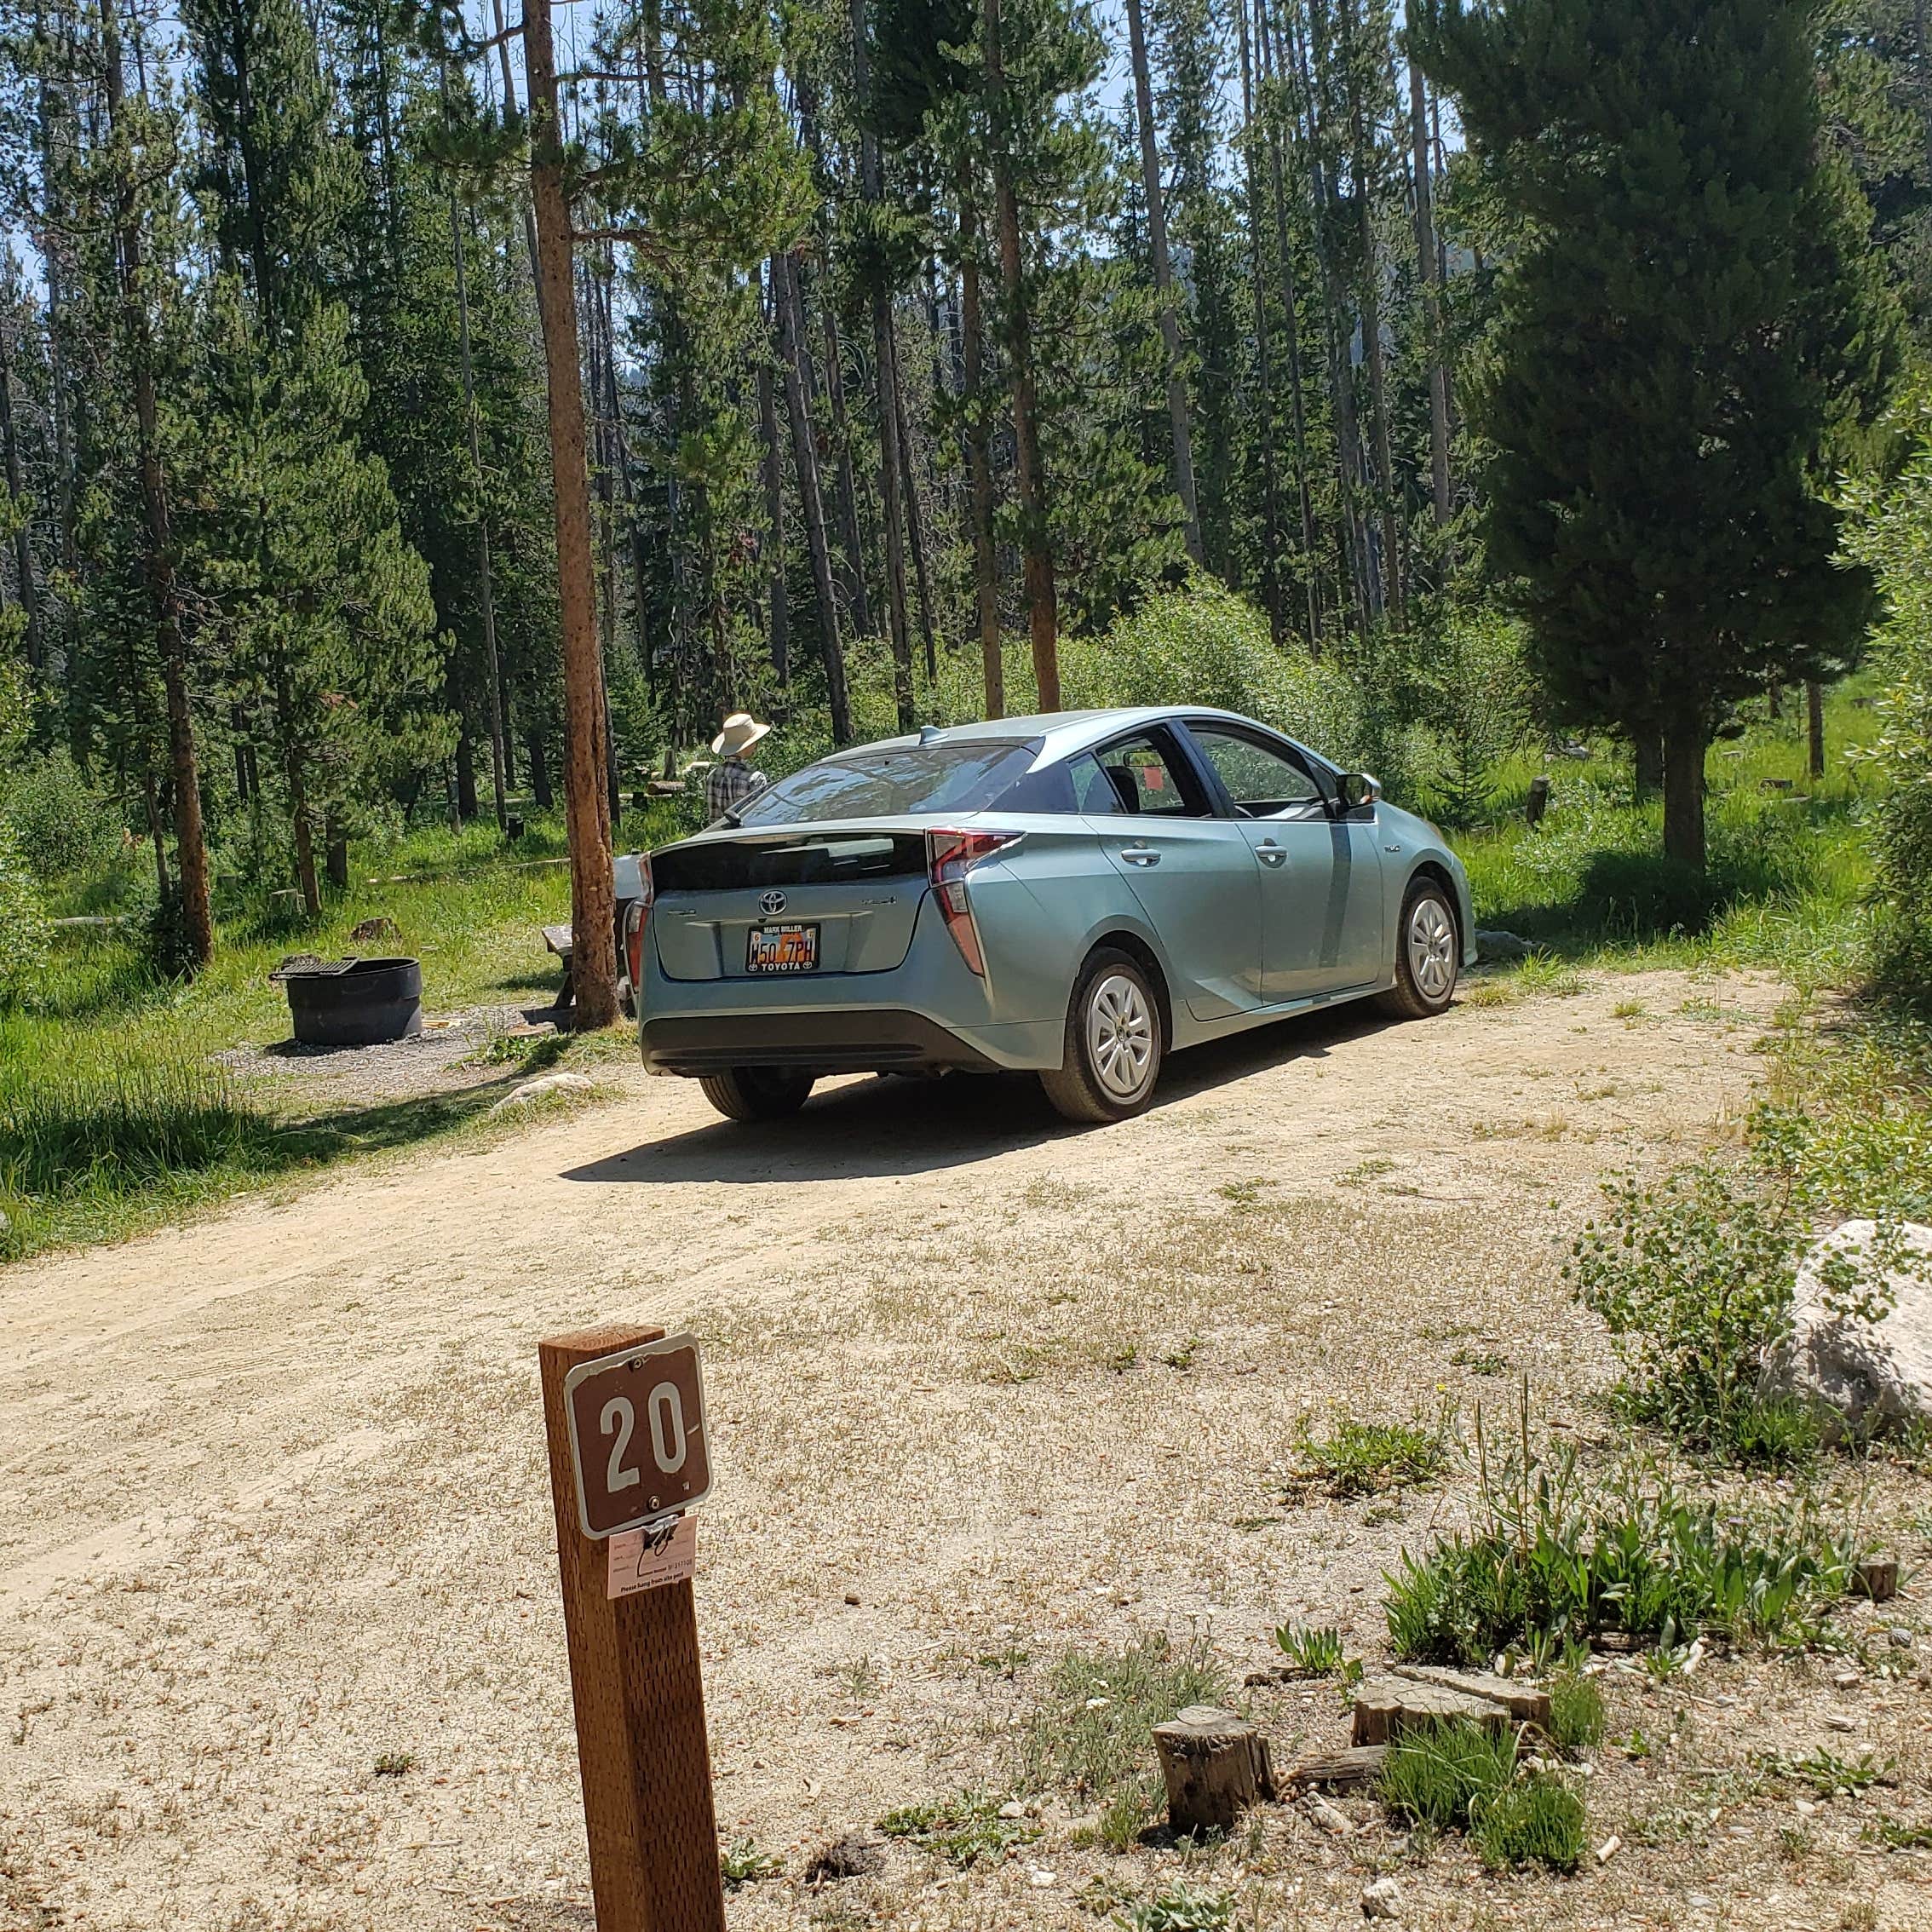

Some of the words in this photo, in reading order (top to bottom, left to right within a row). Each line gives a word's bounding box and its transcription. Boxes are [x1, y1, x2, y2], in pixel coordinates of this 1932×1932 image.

[762, 962, 801, 971] TOYOTA
[600, 1381, 687, 1493] 20
[620, 1584, 637, 1592] Please
